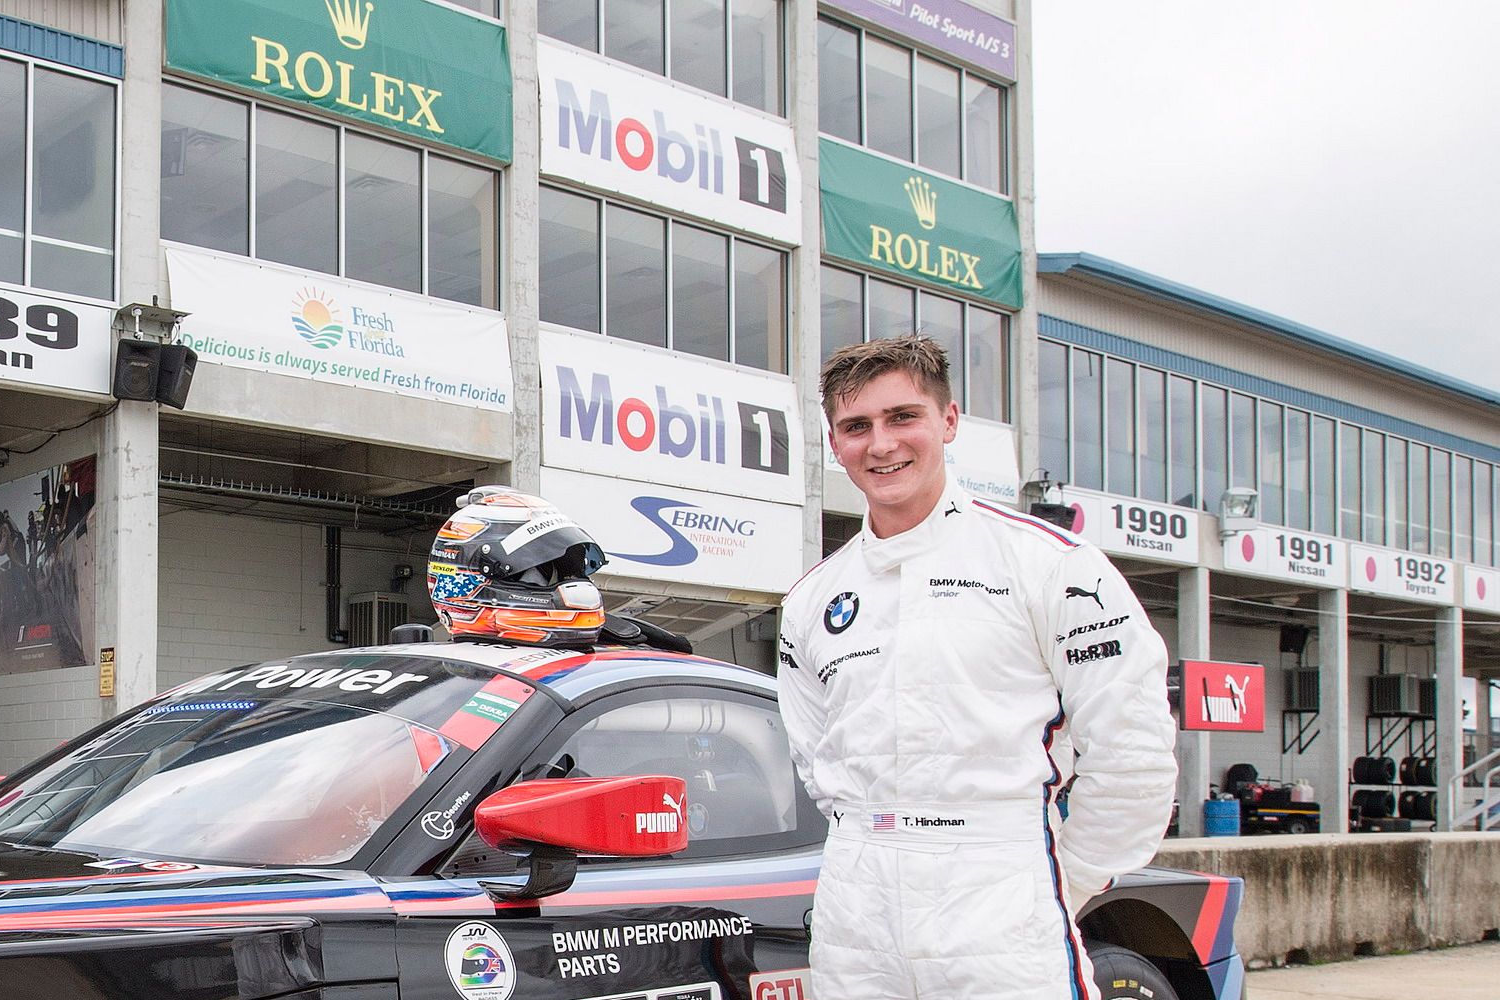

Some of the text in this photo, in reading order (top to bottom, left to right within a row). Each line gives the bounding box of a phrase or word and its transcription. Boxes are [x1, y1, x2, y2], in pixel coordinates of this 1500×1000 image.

[910, 4, 939, 29] Pilot
[941, 18, 975, 45] Sport
[975, 32, 1000, 54] A/S
[1001, 43, 1010, 58] 3
[251, 36, 445, 134] ROLEX
[555, 78, 771, 204] Mobil 1
[869, 224, 983, 290] ROLEX
[351, 306, 395, 333] Fresh
[347, 330, 405, 358] Florida
[181, 333, 506, 405] Delicious is always served Fresh from Florida
[556, 365, 773, 468] Mobil 1
[1111, 503, 1187, 539] 1990
[690, 533, 746, 549] INTERNATIONAL
[702, 546, 735, 557] RACEWAY
[1126, 533, 1173, 553] Nissan
[1275, 534, 1333, 566] 1991
[1288, 561, 1326, 578] Nissan
[1394, 556, 1446, 585] 1992
[929, 590, 960, 598] Junior
[930, 579, 1009, 595] BMW Motorsport
[1404, 580, 1437, 596] Toyota
[827, 592, 859, 611] BMW
[1068, 615, 1129, 639] DUNLOP
[830, 647, 881, 668] PERFORMANCE
[217, 665, 430, 695] Power
[479, 704, 507, 718] DEKRA
[635, 812, 678, 834] PUMA
[902, 817, 965, 826] T. Hindman
[552, 917, 753, 953] BMW M PERFORMANCE
[558, 954, 621, 978] PARTS
